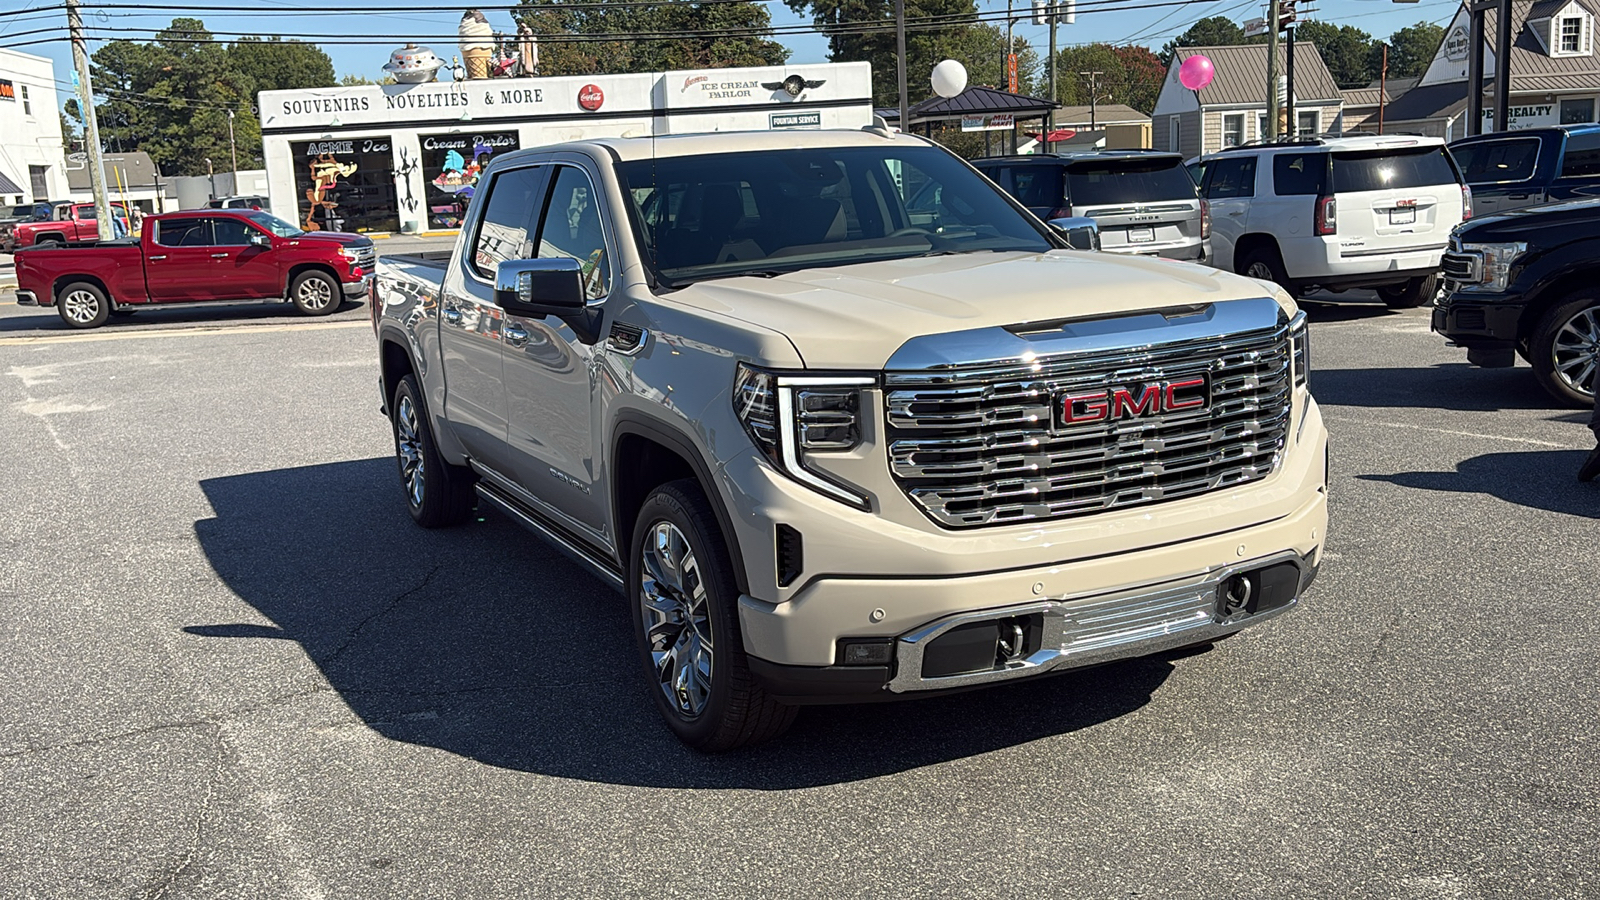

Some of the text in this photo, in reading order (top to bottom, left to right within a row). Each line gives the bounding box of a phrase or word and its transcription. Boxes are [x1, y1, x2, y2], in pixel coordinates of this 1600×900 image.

[701, 81, 758, 91] ICE CREAM
[709, 90, 751, 99] PARLOR
[283, 89, 543, 115] SOUVENIRS NOVELTIES & MORE
[1508, 105, 1552, 118] REALTY
[773, 115, 819, 125] FOUNTAIN SERVICE
[307, 139, 389, 156] ACME Ice
[424, 135, 516, 150] Cream Parlor
[1396, 199, 1418, 207] GMC
[1061, 376, 1204, 425] GMC
